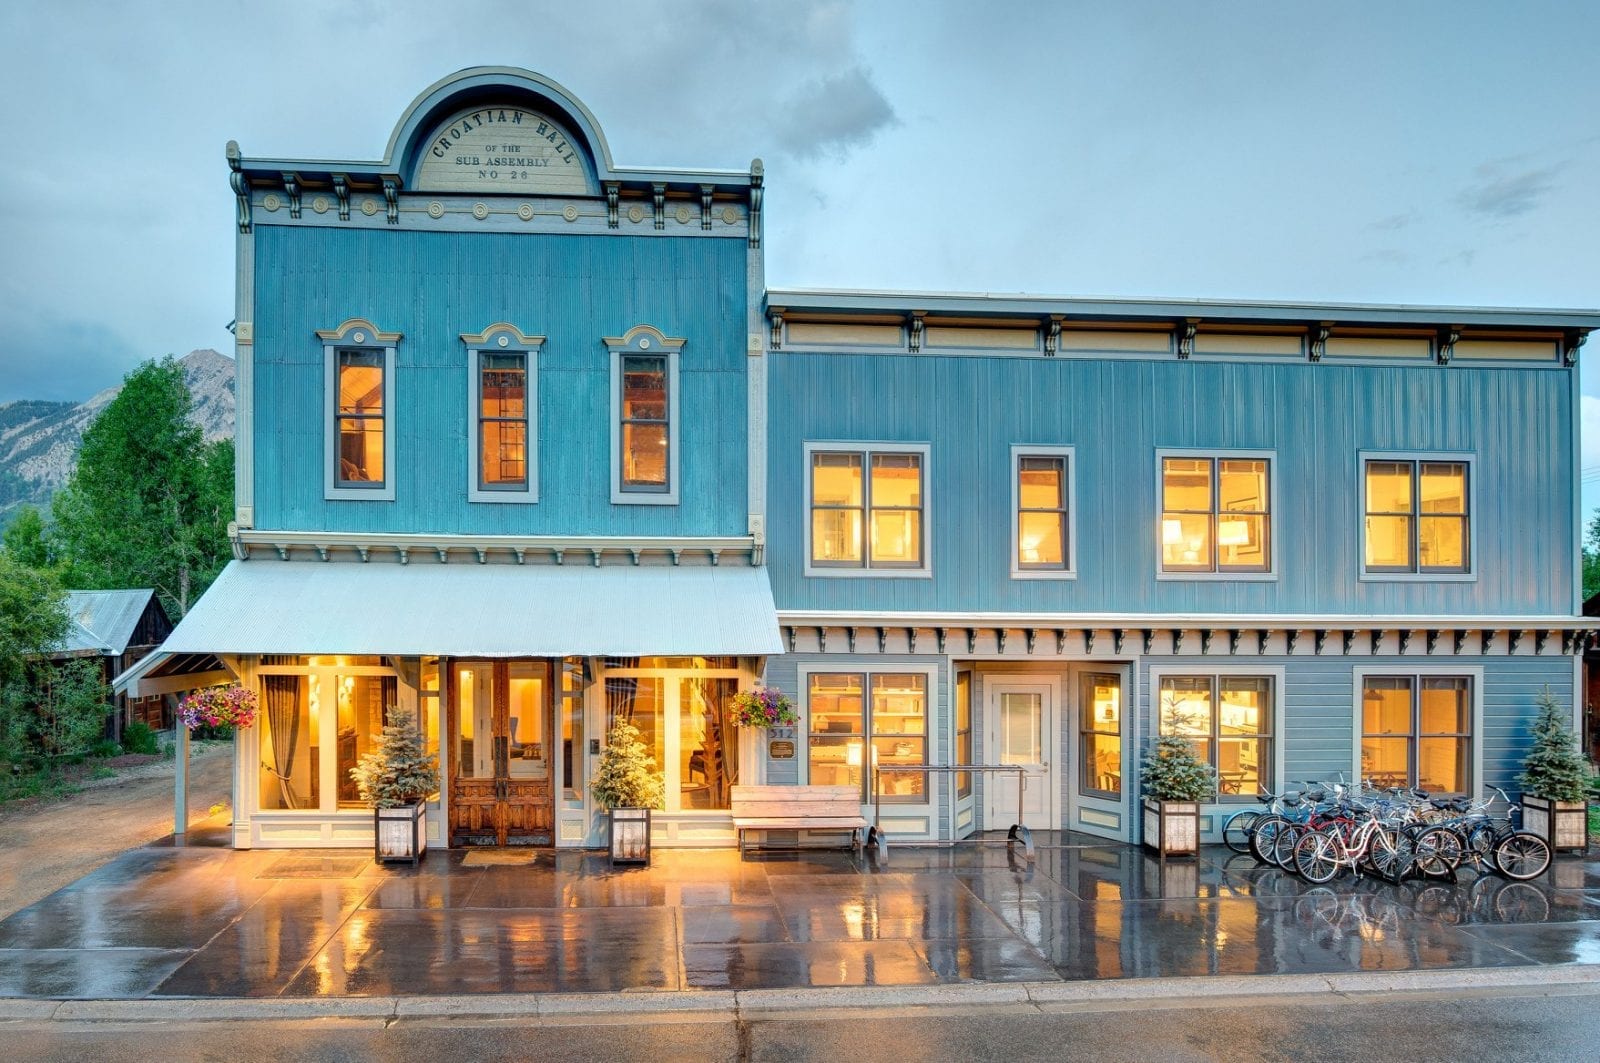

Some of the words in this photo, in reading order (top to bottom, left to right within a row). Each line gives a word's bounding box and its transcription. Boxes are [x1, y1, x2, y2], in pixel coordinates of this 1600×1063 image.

[433, 110, 523, 158] CROATIAN
[536, 122, 576, 164] HALL
[503, 145, 521, 153] THE
[456, 156, 480, 165] SUB
[486, 157, 550, 168] ASSEMBLY
[478, 170, 498, 179] NO
[770, 729, 793, 738] 512
